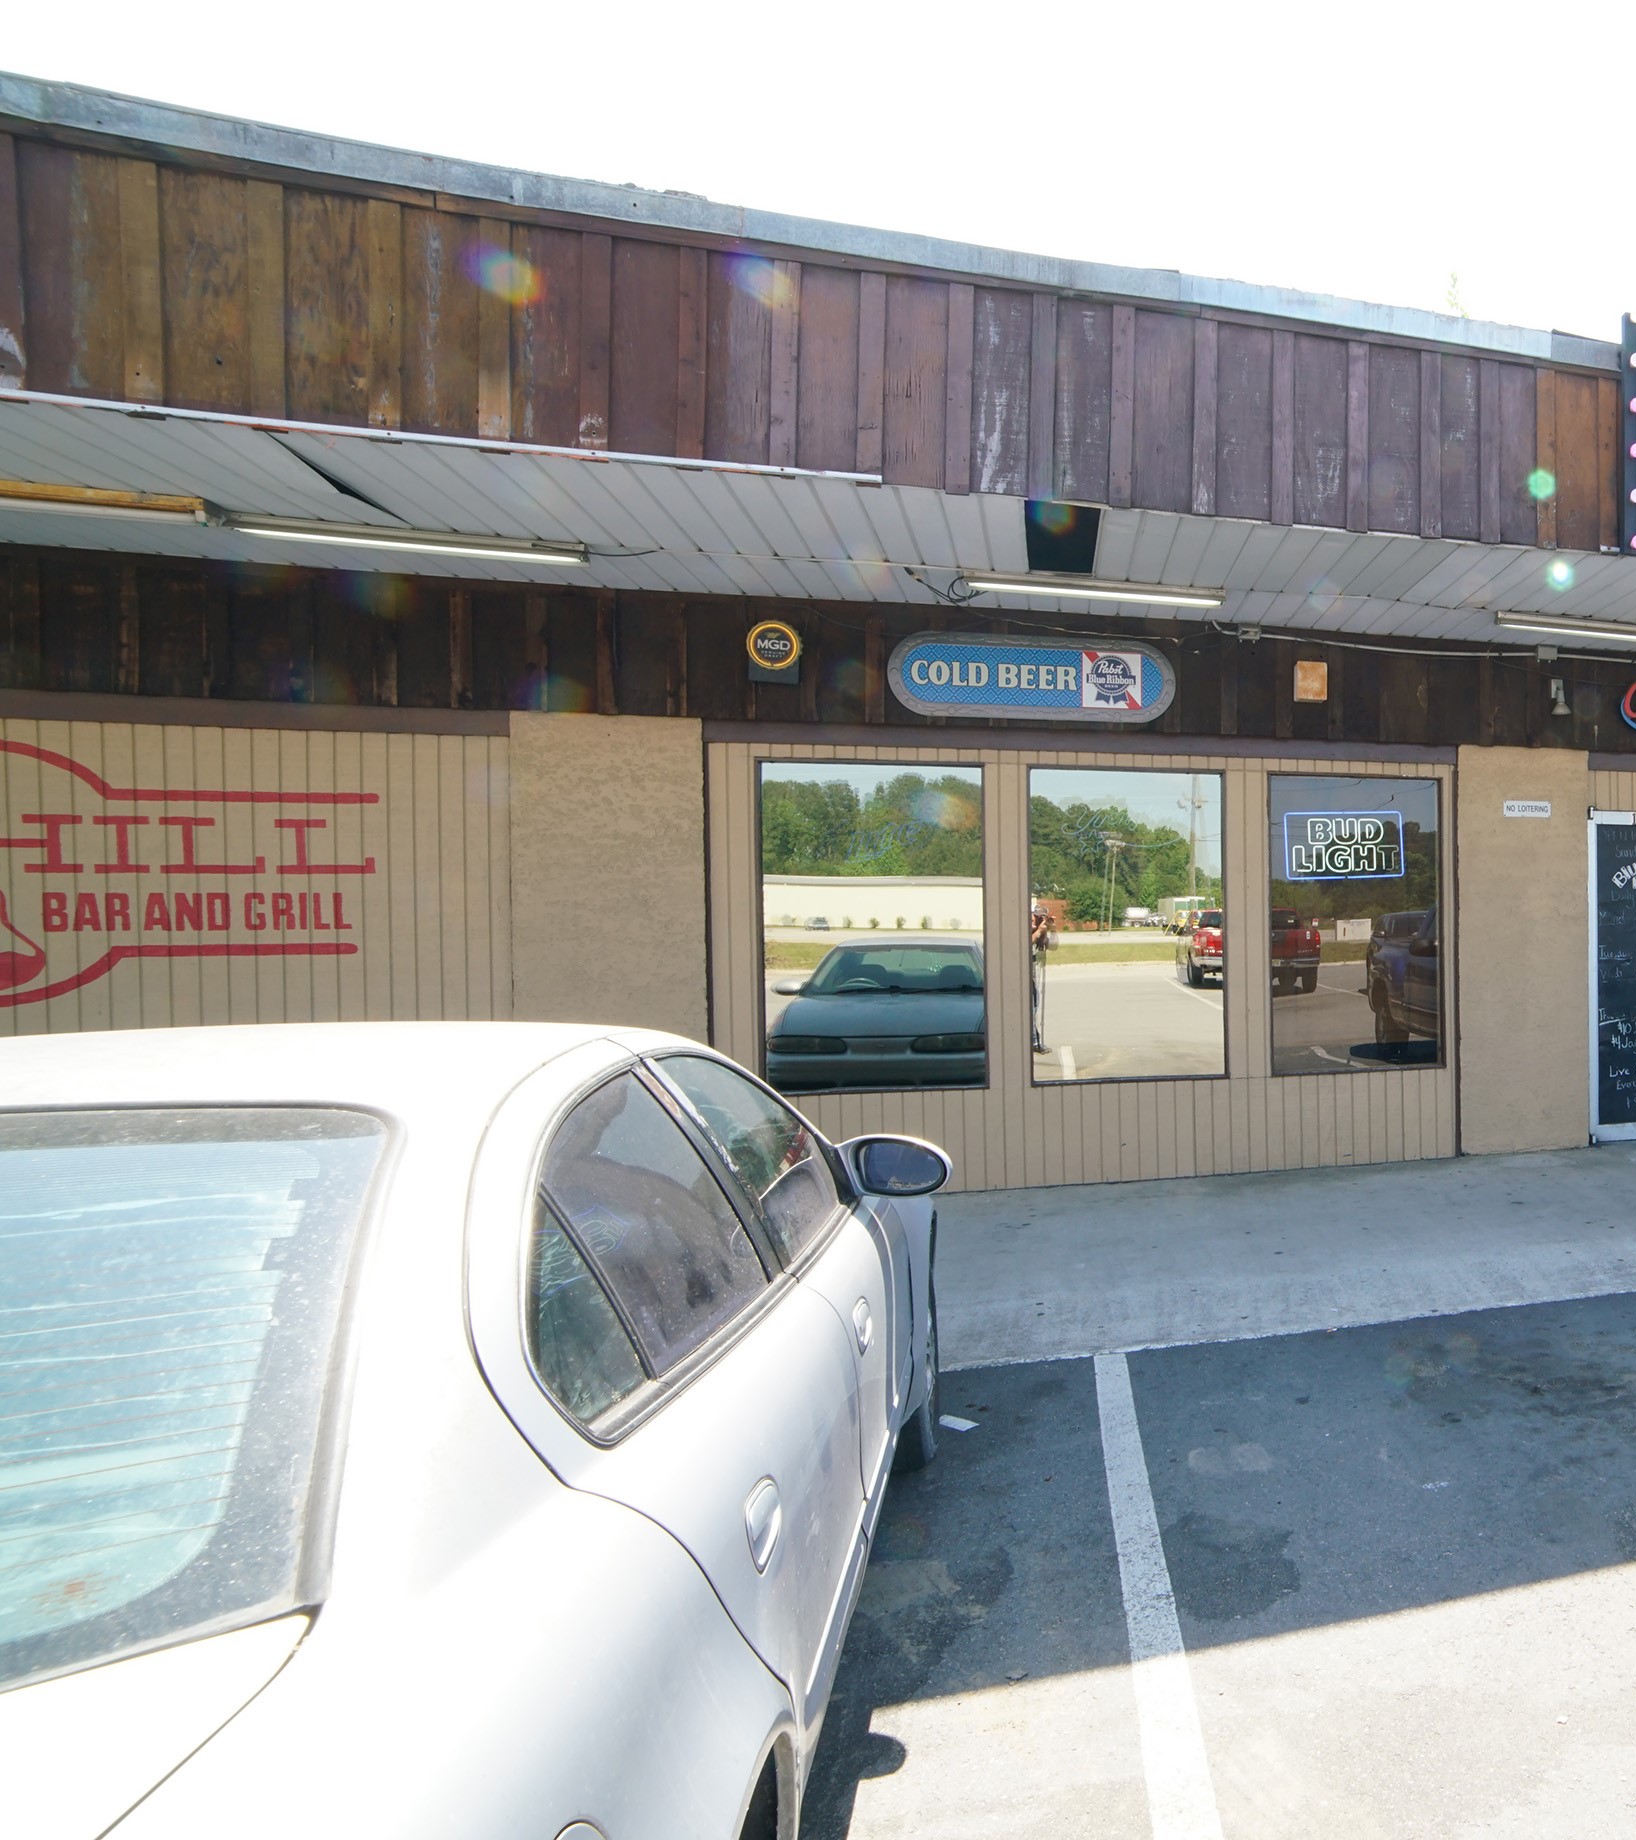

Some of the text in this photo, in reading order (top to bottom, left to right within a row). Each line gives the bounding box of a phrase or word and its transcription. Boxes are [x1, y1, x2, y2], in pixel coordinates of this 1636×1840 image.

[757, 639, 791, 651] MGD
[1097, 660, 1124, 674] Pabst
[910, 659, 1079, 691] COLD BEER
[1088, 673, 1135, 686] Blue Ribbon
[1506, 804, 1549, 813] NO LOITERING
[1292, 818, 1400, 873] BUD LIGHT
[42, 892, 353, 932] BAR AND GRILL
[1609, 1065, 1630, 1078] Live
